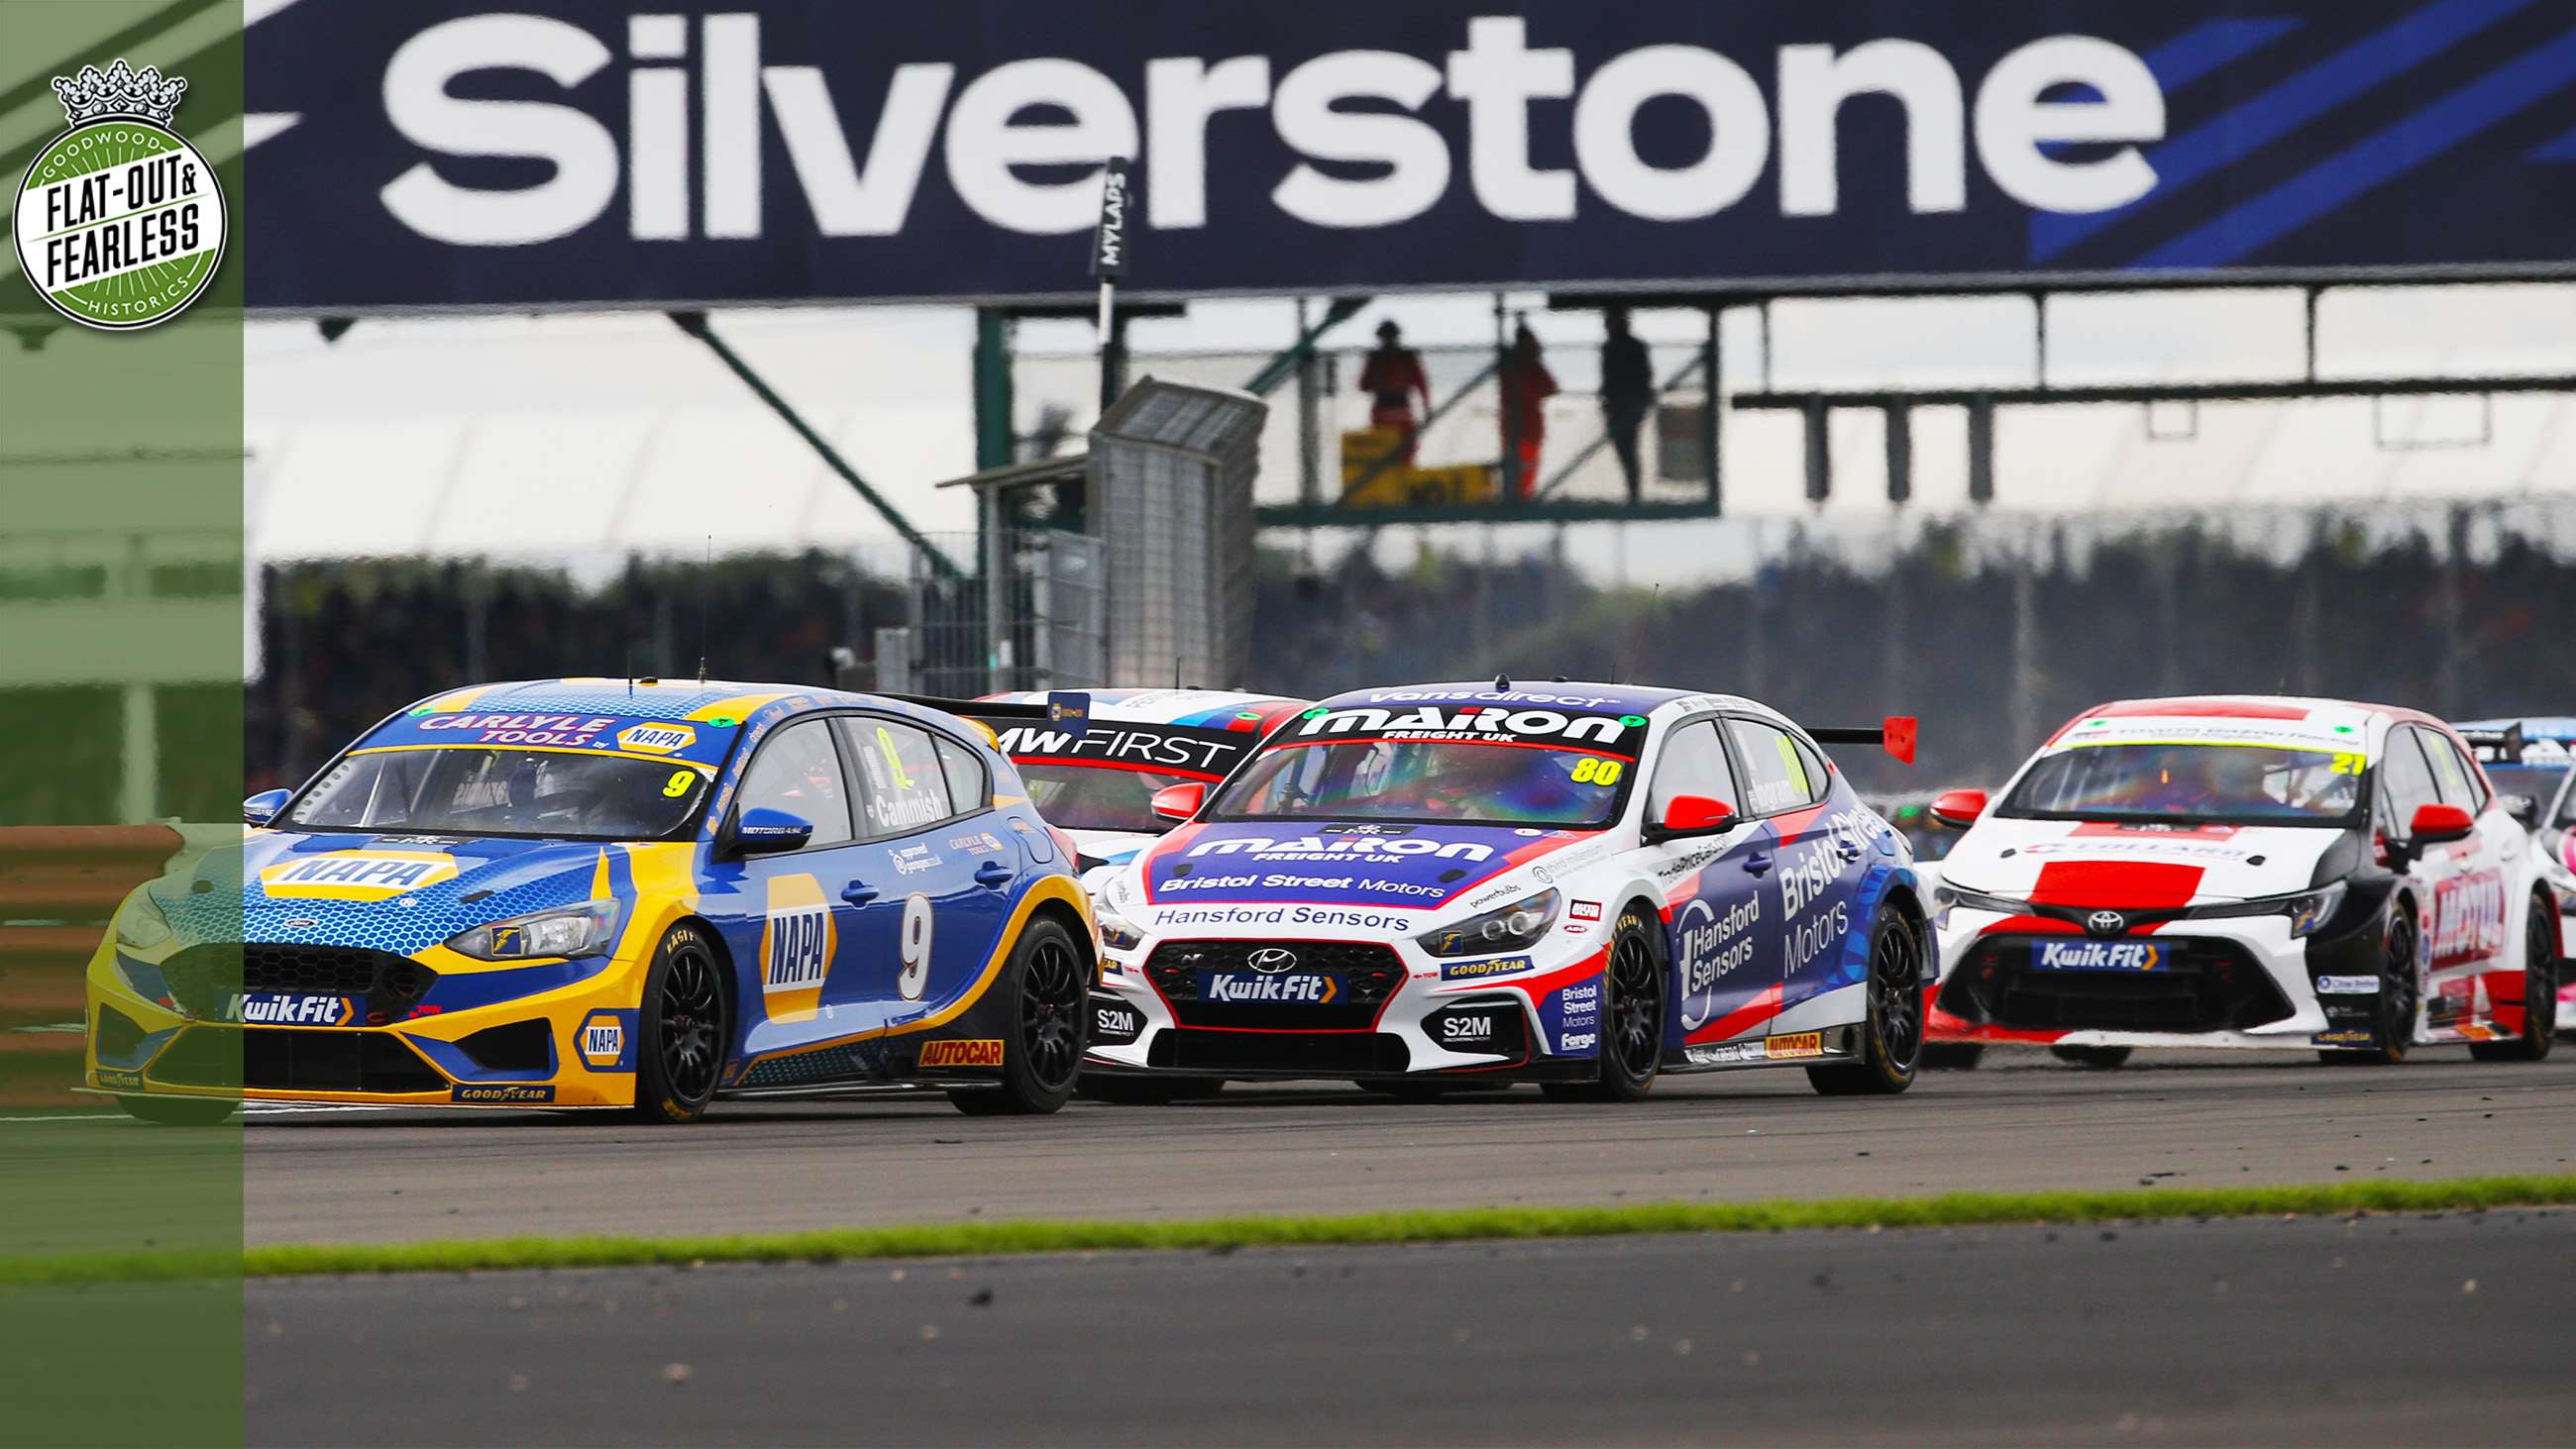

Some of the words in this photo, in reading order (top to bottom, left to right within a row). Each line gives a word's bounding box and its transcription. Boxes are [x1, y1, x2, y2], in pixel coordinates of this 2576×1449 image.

[380, 11, 2167, 245] Silverstone
[1101, 172, 1127, 265] MYLAPS
[418, 714, 617, 733] CARLYLE
[479, 730, 594, 747] TOOLS
[625, 728, 685, 751] NAPA
[998, 728, 1071, 754] MW
[1382, 730, 1479, 741] FREIGHT
[1482, 732, 1518, 743] UK
[1570, 758, 1623, 786] 80
[2329, 752, 2365, 776] 21
[662, 770, 697, 798] 9
[875, 789, 943, 828] Cammish
[1252, 851, 1362, 863] FREIGHT
[1363, 854, 1405, 864] UK
[286, 860, 430, 885] NAPA
[1158, 875, 1258, 893] Bristol
[1262, 874, 1353, 889] Street
[1358, 878, 1446, 898] Motors
[1154, 907, 1284, 926] Hansford
[1292, 906, 1410, 931] Sensors
[1692, 890, 1761, 959] Hansford
[769, 912, 824, 985] NAPA
[898, 891, 934, 1002] 9
[1783, 900, 1850, 980] Motors
[1449, 959, 1526, 976] GOODYEAR
[1691, 935, 1754, 992] Sensors
[1562, 985, 1597, 1001] Bristol
[1563, 999, 1597, 1015] Street
[1097, 1009, 1133, 1031] S2M
[1443, 1017, 1490, 1037] S2M
[1562, 1015, 1595, 1028] Motors
[589, 1028, 620, 1052] NAPA
[920, 1041, 1004, 1066] AUTOCAR
[462, 1087, 547, 1101] GOODYEAR
